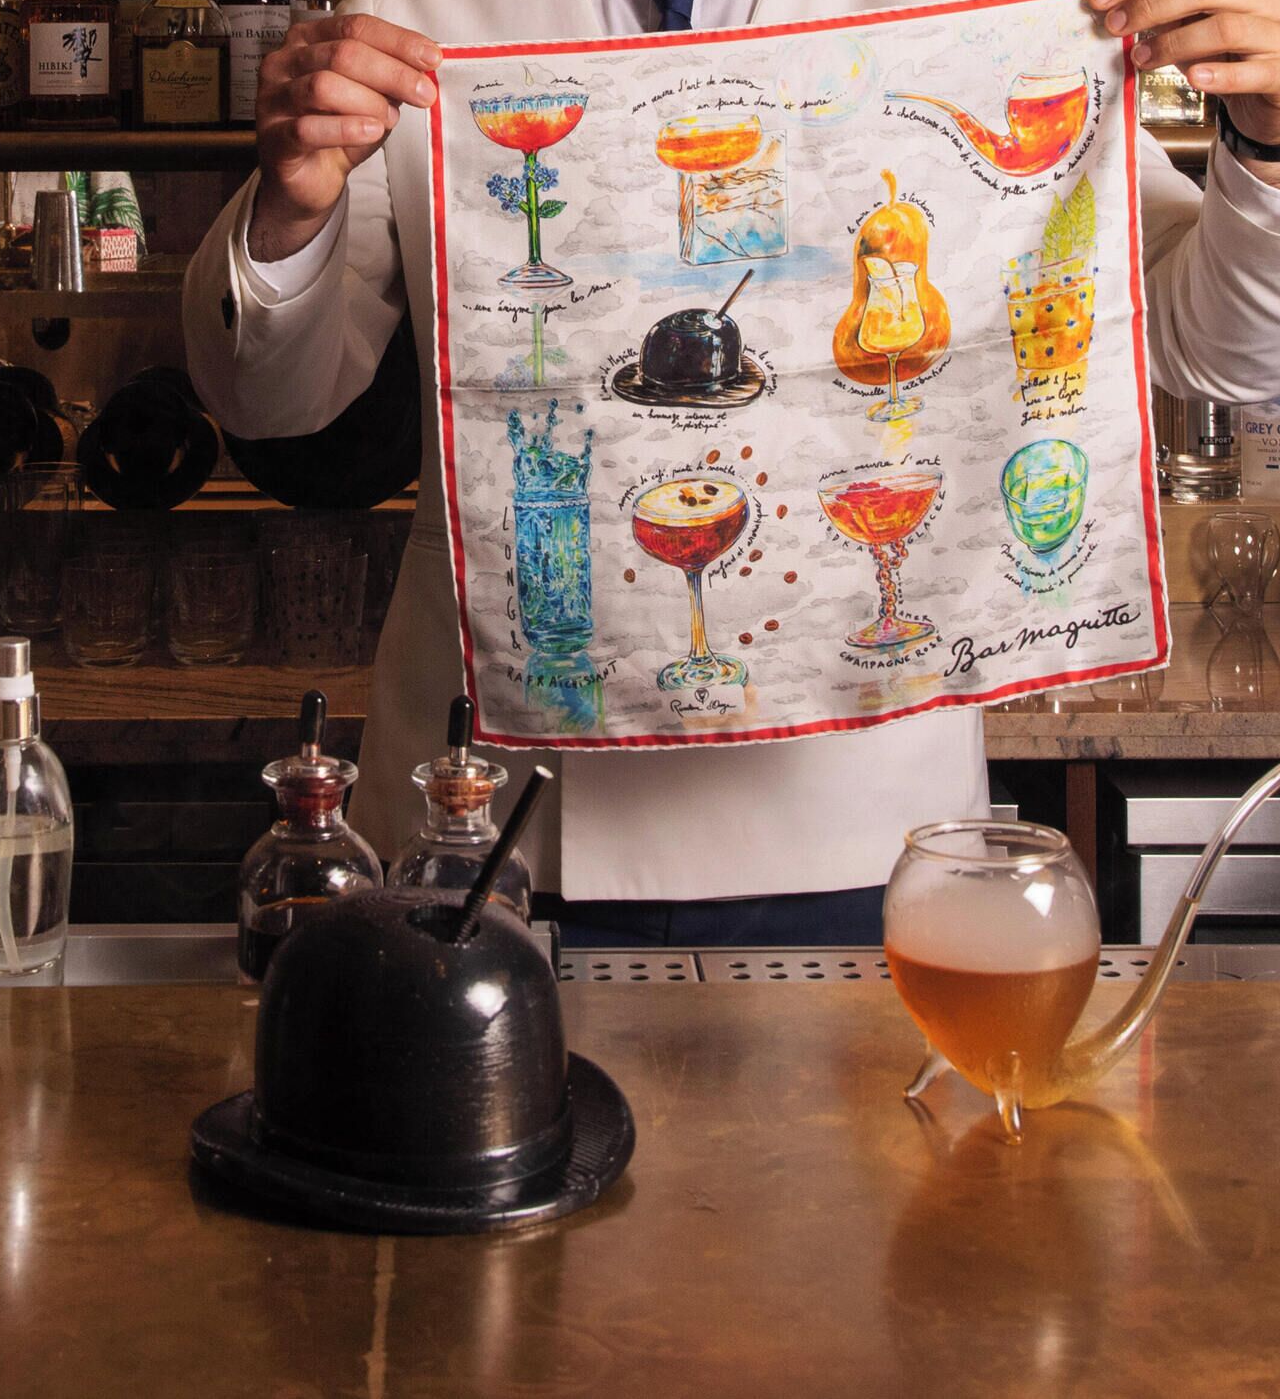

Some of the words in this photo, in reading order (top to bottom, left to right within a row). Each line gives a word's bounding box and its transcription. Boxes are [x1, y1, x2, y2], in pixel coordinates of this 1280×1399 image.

[39, 62, 72, 70] HIBIKI
[632, 101, 646, 114] une
[678, 78, 702, 92] d'art
[706, 75, 717, 86] de
[714, 97, 749, 111] punch
[753, 94, 776, 109] doux
[784, 101, 795, 110] et
[960, 152, 972, 163] de
[898, 192, 907, 201] 3
[571, 291, 584, 303] les
[647, 409, 680, 424] hommage
[719, 412, 727, 420] et
[1046, 407, 1055, 419] de
[1246, 422, 1273, 434] GREY
[819, 469, 848, 482] une
[819, 514, 863, 552] VODKA
[708, 556, 736, 588] profond
[737, 547, 744, 557] et
[503, 507, 516, 620] LONG
[511, 630, 522, 650] &
[839, 651, 910, 669] CHAMPAGNE
[943, 637, 1014, 677] Bar
